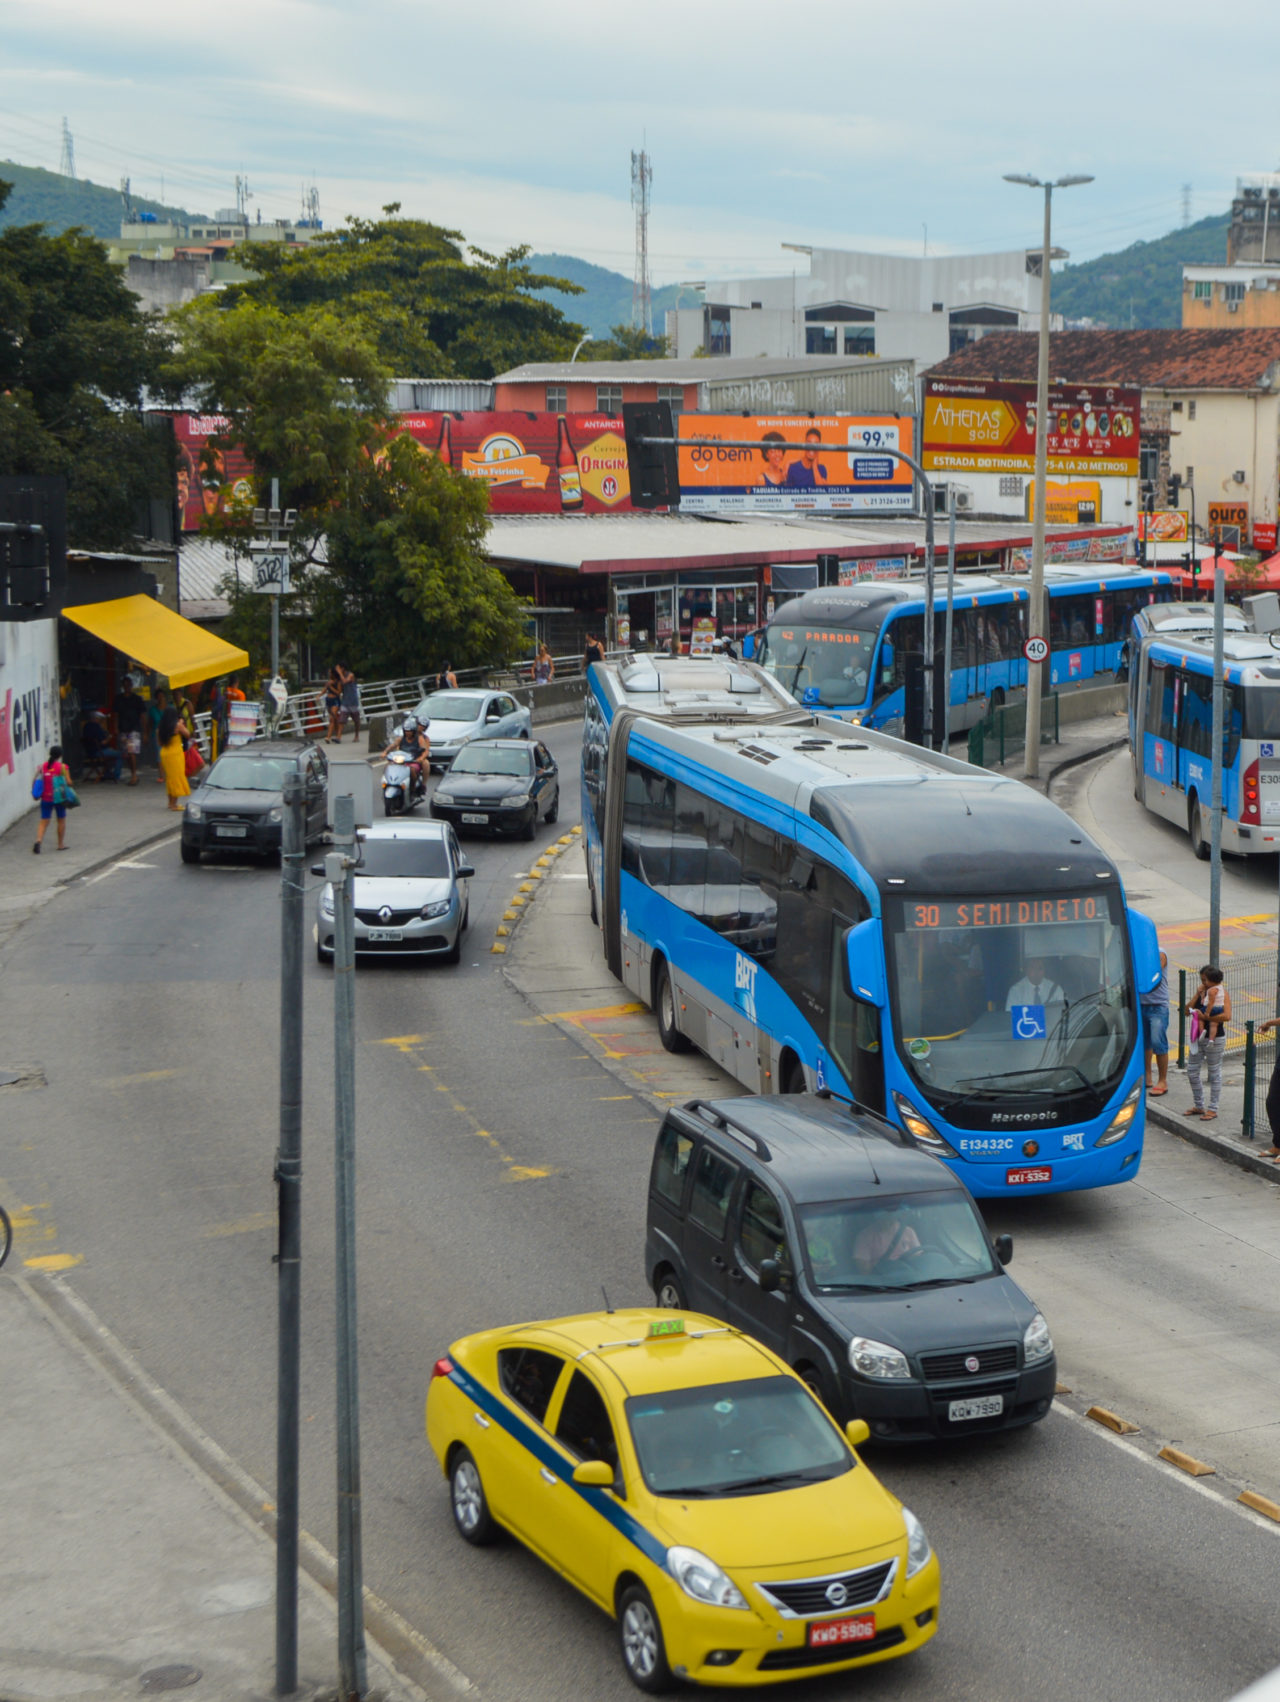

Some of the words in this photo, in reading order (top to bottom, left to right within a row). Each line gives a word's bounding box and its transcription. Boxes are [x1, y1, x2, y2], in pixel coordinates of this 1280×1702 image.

[933, 402, 1000, 429] ATHENAS
[584, 420, 625, 429] ANTARCTI
[969, 429, 1000, 442] gold
[934, 456, 975, 467] ESTRADA
[1090, 462, 1128, 472] METROS)
[1210, 508, 1247, 521] ouro
[1028, 642, 1046, 655] 40
[915, 905, 939, 927] 30
[735, 952, 757, 1000] BRT
[991, 1111, 1058, 1122] Marcopolo
[960, 1138, 1013, 1150] E13432C
[1063, 1132, 1085, 1146] BRT
[651, 1319, 684, 1336] TAXI
